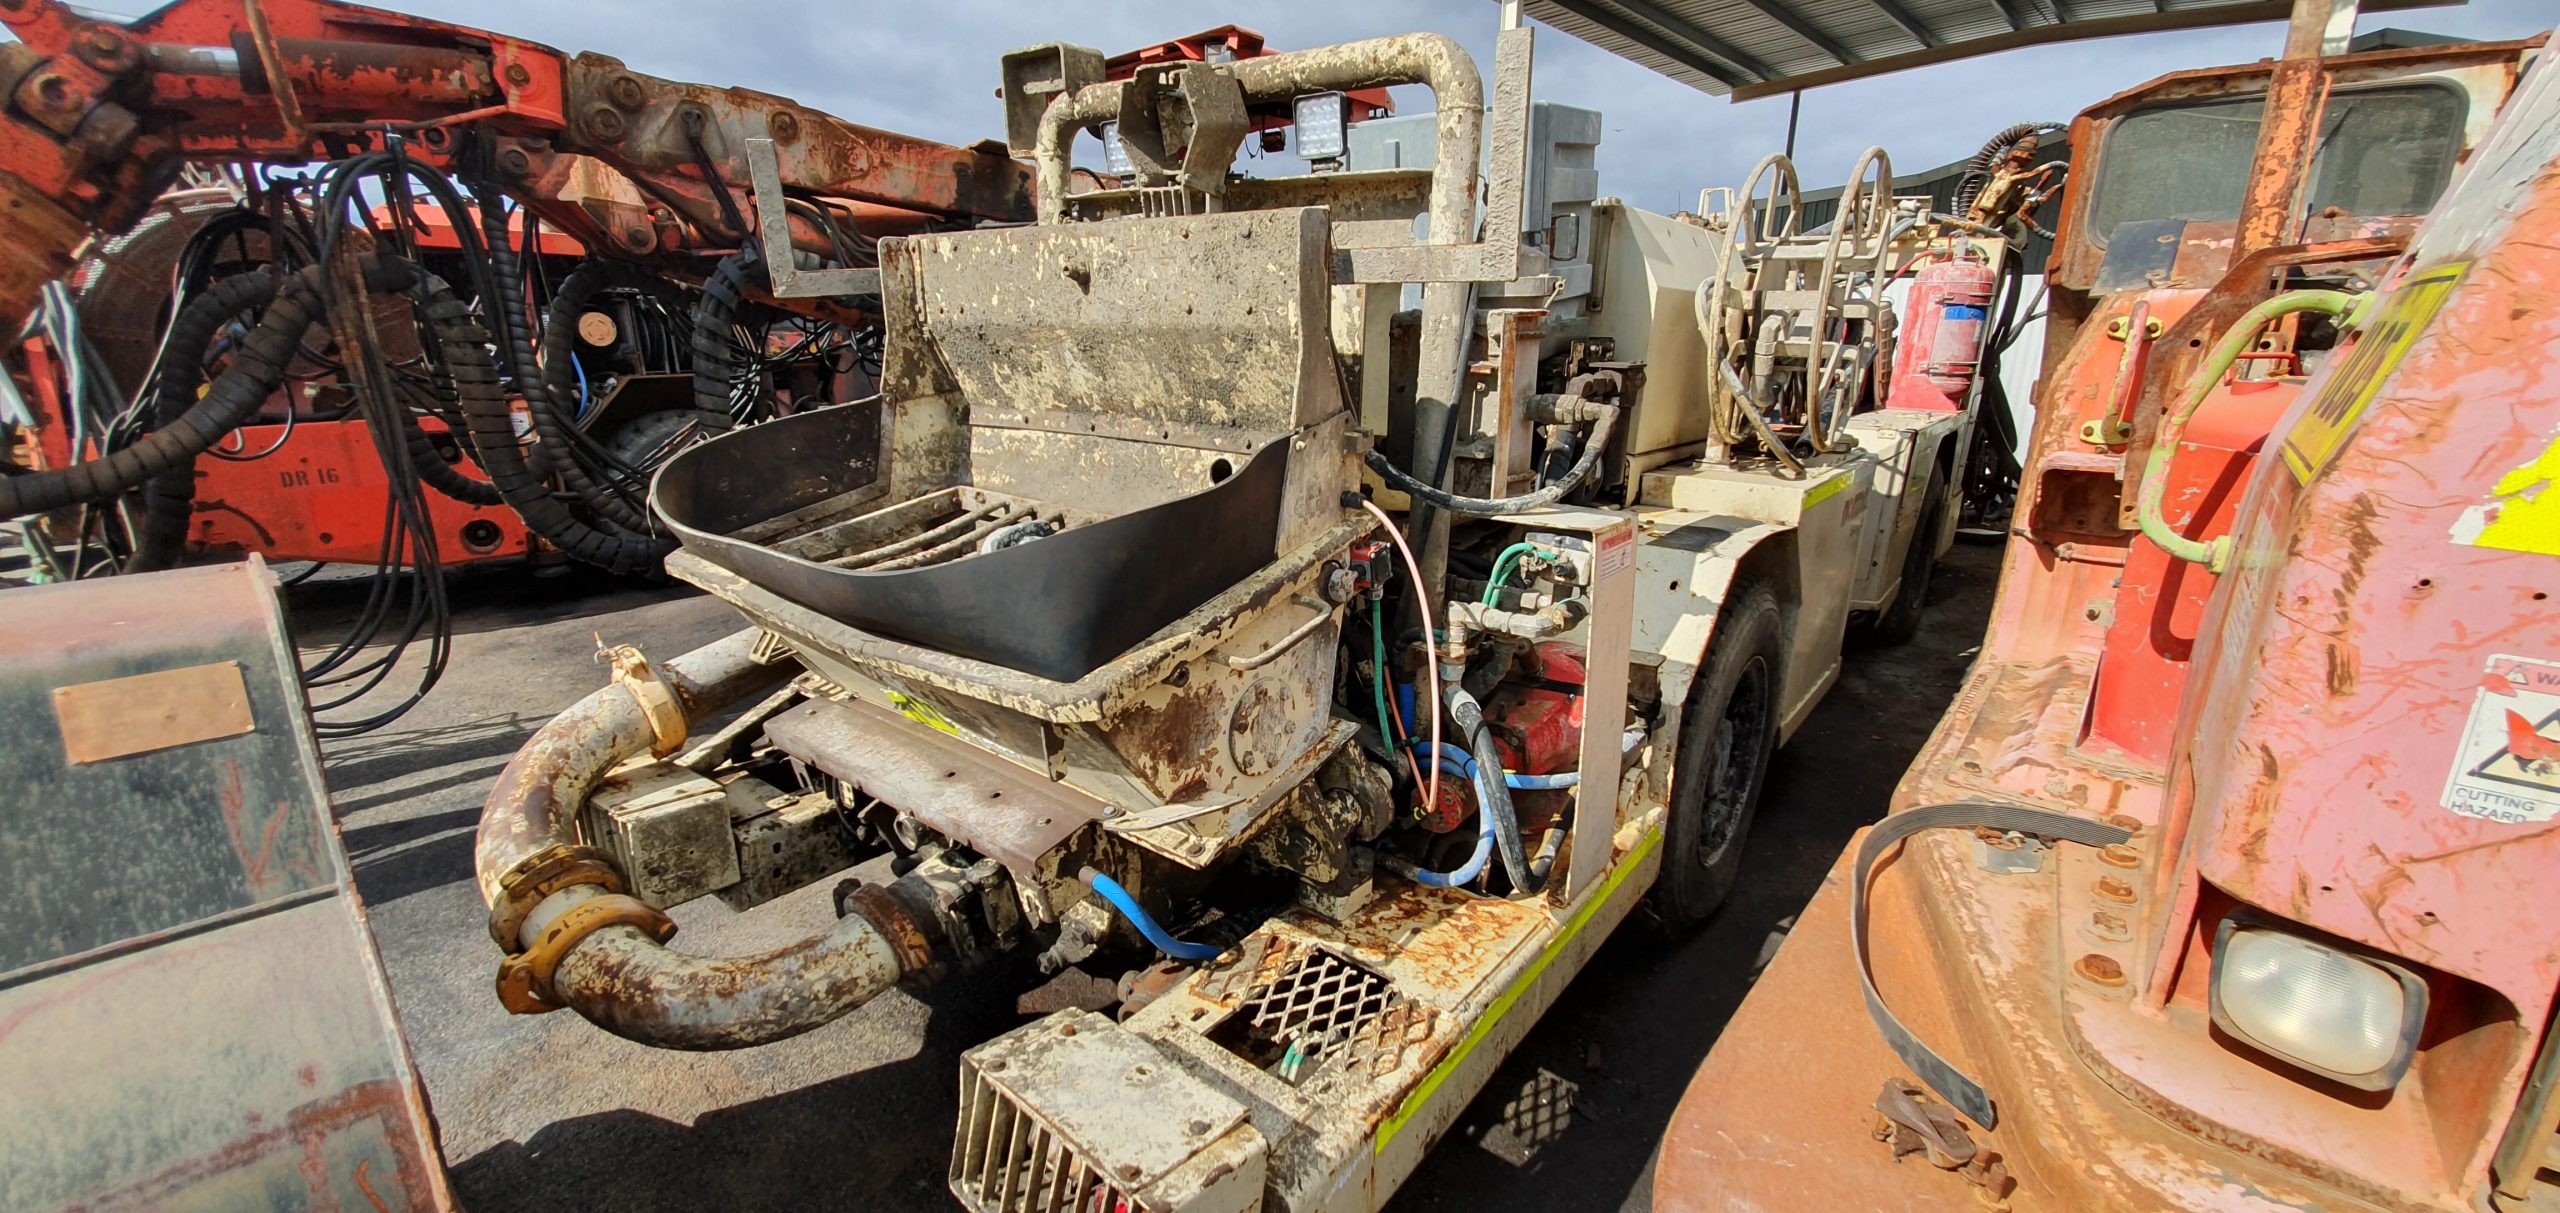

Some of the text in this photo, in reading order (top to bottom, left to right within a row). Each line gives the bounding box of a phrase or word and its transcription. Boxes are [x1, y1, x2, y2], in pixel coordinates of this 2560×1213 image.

[280, 468, 340, 488] DR 16
[2455, 787, 2536, 812] CUTTING
[2451, 801, 2527, 822] HAZARD
